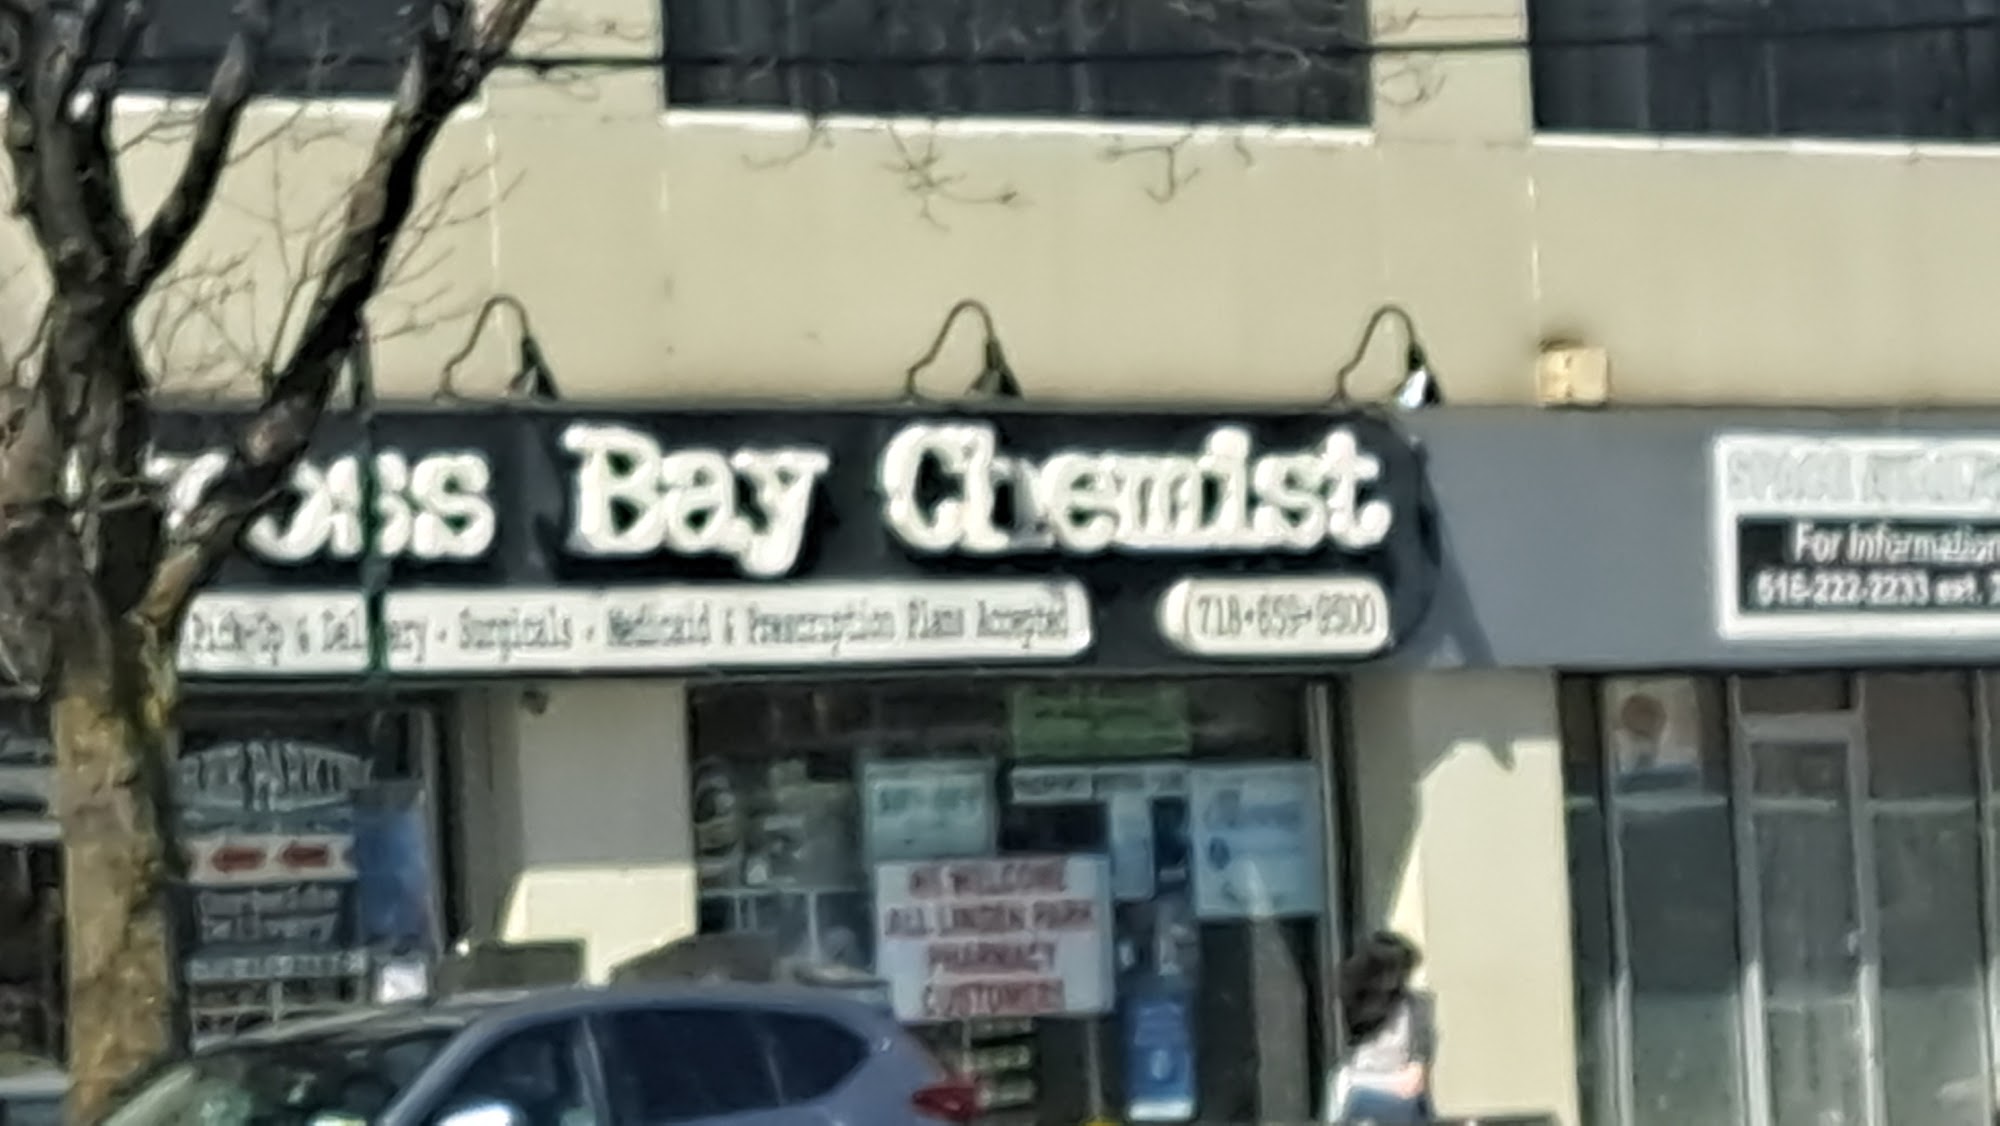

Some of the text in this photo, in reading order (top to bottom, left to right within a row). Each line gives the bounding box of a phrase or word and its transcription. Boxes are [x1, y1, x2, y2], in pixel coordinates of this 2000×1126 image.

[80, 422, 1392, 578] ross Bay Chemist
[1795, 521, 1842, 563] For
[459, 604, 573, 662] Surgicals
[908, 599, 965, 640] Plans
